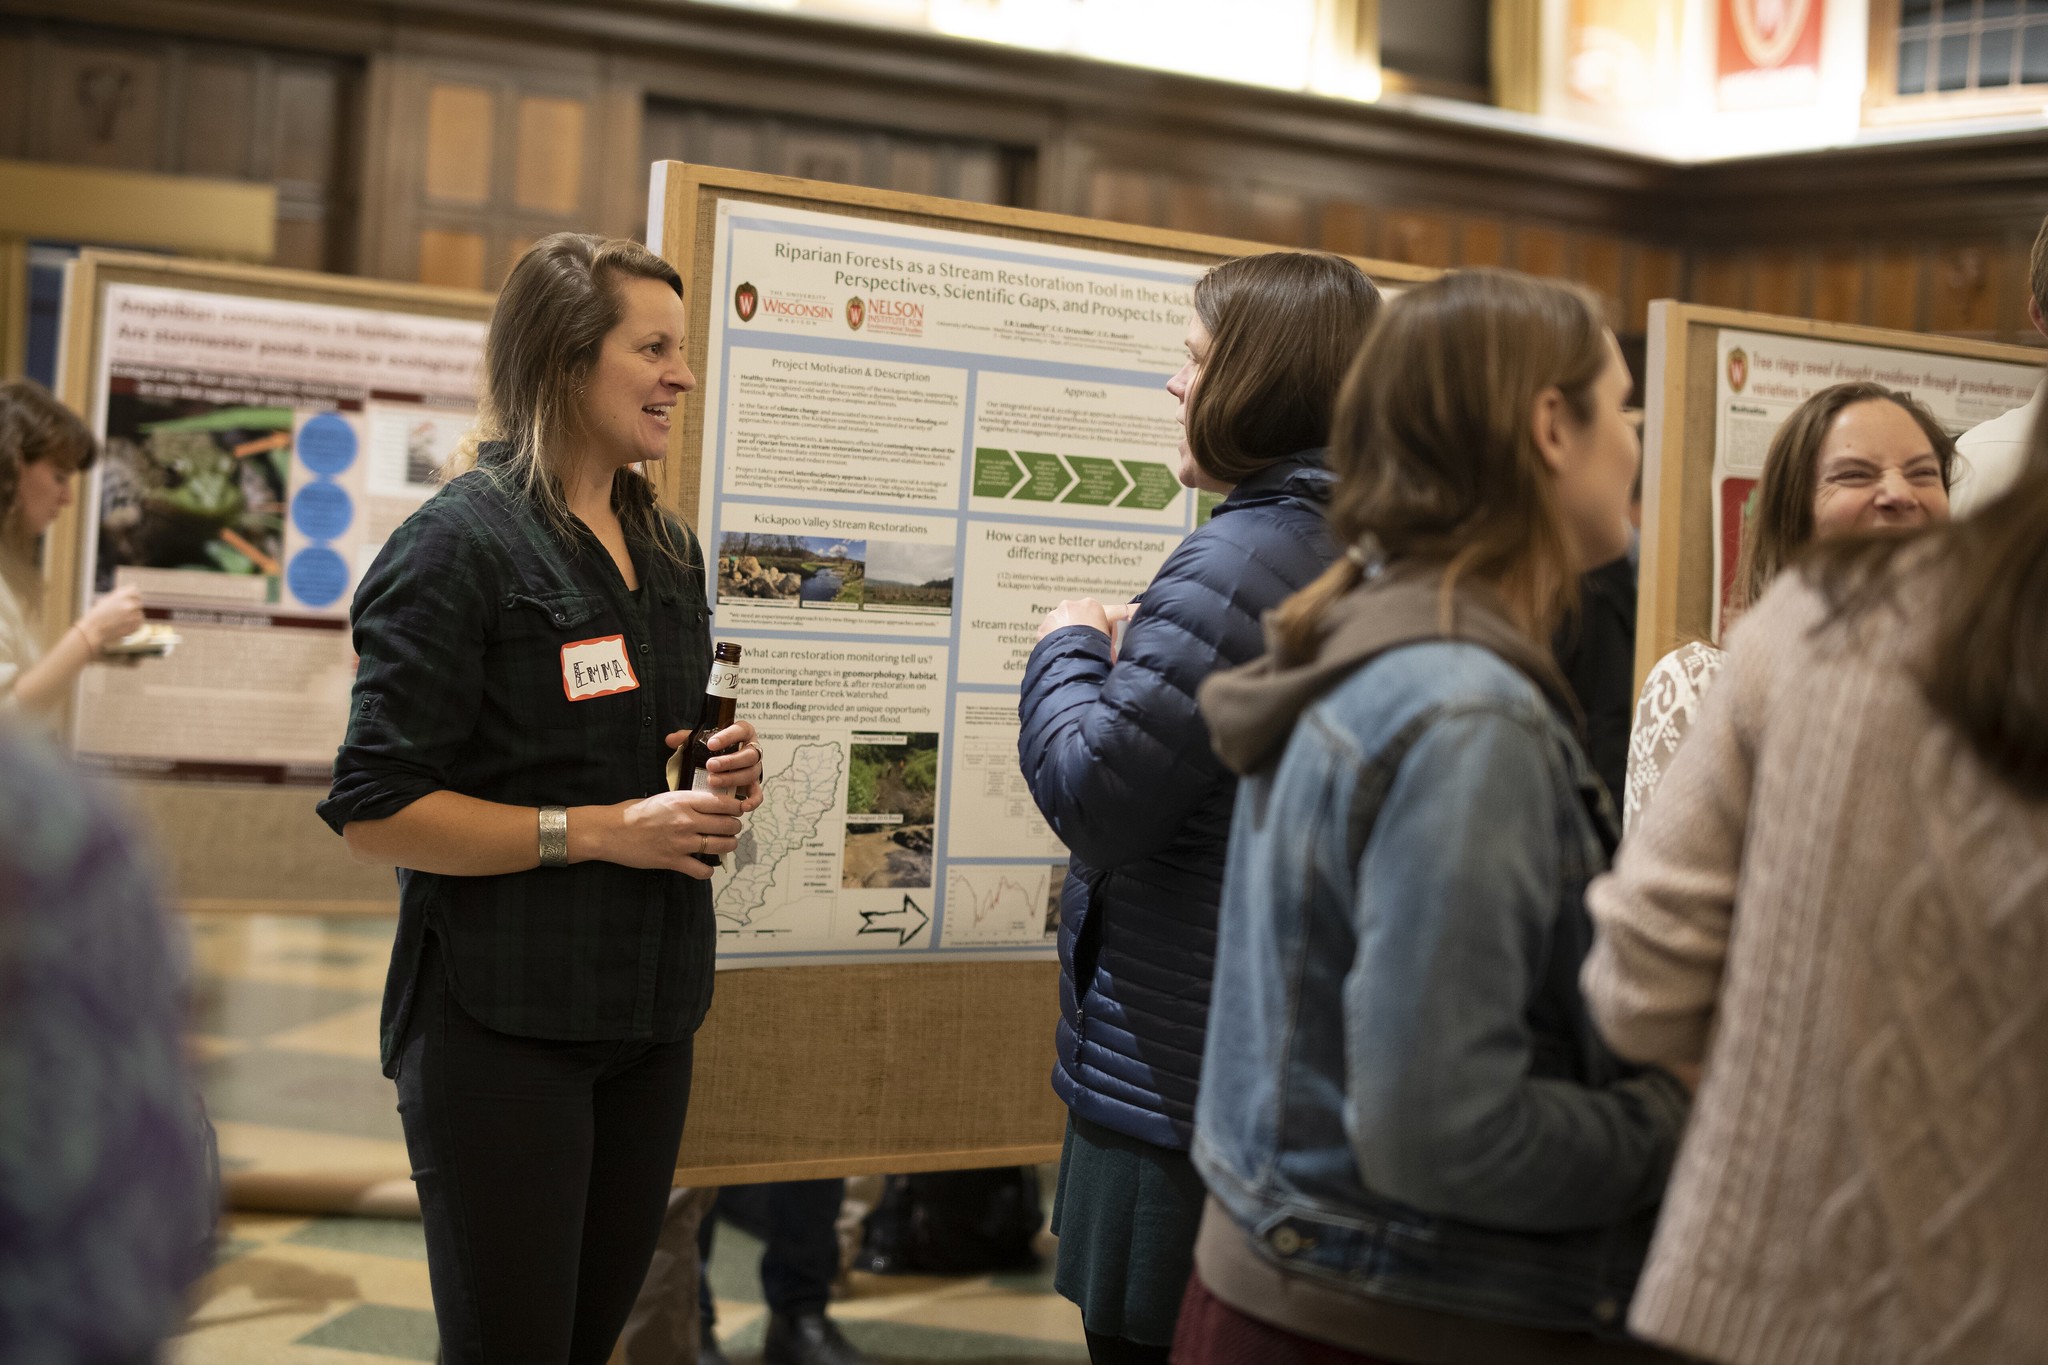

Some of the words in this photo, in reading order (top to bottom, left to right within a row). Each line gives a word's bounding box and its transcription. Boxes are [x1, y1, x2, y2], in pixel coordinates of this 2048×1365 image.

[775, 242, 841, 267] Riparian
[846, 251, 903, 271] Forests
[907, 261, 923, 274] as
[927, 263, 935, 275] a
[939, 262, 994, 282] Stream
[997, 269, 1084, 293] Restoration
[1086, 280, 1117, 297] Tool
[1120, 284, 1133, 299] in
[1136, 286, 1160, 302] the
[1162, 289, 1194, 306] Kick
[834, 269, 940, 299] Perspectives,
[943, 281, 1015, 305] Scientific
[1018, 291, 1060, 313] Gaps,
[1062, 296, 1088, 313] and
[1091, 301, 1163, 325] Prospects
[1165, 308, 1185, 325] for
[867, 298, 924, 319] NELSON
[867, 314, 905, 325] INSTITUTE
[907, 318, 922, 327] FOR
[772, 357, 808, 373] Project
[810, 360, 862, 375] Motivation
[865, 367, 871, 376] &
[874, 367, 930, 384] Description
[1752, 351, 1773, 369] Tree
[1776, 355, 1799, 376] rings
[1803, 357, 1832, 376] reveal
[1835, 359, 1872, 383] drought
[1922, 370, 1957, 393] through
[1064, 385, 1107, 401] Approach
[1751, 380, 1799, 400] variations
[753, 513, 801, 527] Kickapoo
[801, 516, 829, 530] Valley
[831, 518, 867, 530] Stream
[868, 521, 928, 534] Restorations
[986, 529, 1013, 542] How
[1015, 533, 1036, 544] can
[1039, 535, 1055, 545] we
[1058, 533, 1096, 548] better
[1097, 536, 1165, 552] understand
[1006, 545, 1059, 564] differing
[1060, 549, 1142, 569] perspectives?
[971, 619, 1007, 629] stream
[1007, 621, 1041, 631] restor
[743, 647, 769, 658] What
[770, 650, 788, 658] can
[790, 649, 844, 660] restoration
[846, 650, 899, 665] monitoring
[900, 653, 916, 663] tell
[917, 654, 933, 664] us?
[573, 659, 627, 689] EMMA
[751, 665, 797, 677] monitoring
[798, 666, 831, 678] changes
[833, 668, 840, 676] in
[909, 670, 938, 681] habitat,
[760, 677, 813, 687] temperature
[814, 678, 841, 687] before
[851, 679, 868, 688] after
[871, 680, 915, 689] restoration
[766, 687, 774, 695] in
[775, 687, 789, 696] the
[790, 688, 818, 696] Tainter
[820, 689, 845, 697] Creek
[736, 701, 749, 709] ust
[751, 701, 770, 709] 2018
[771, 700, 807, 712] flooding
[808, 703, 843, 713] provided
[855, 704, 883, 714] unique
[884, 704, 930, 716] opportunity
[757, 711, 790, 720] channel
[791, 712, 825, 723] changes
[843, 713, 858, 722] and
[785, 732, 820, 740] Watershed
